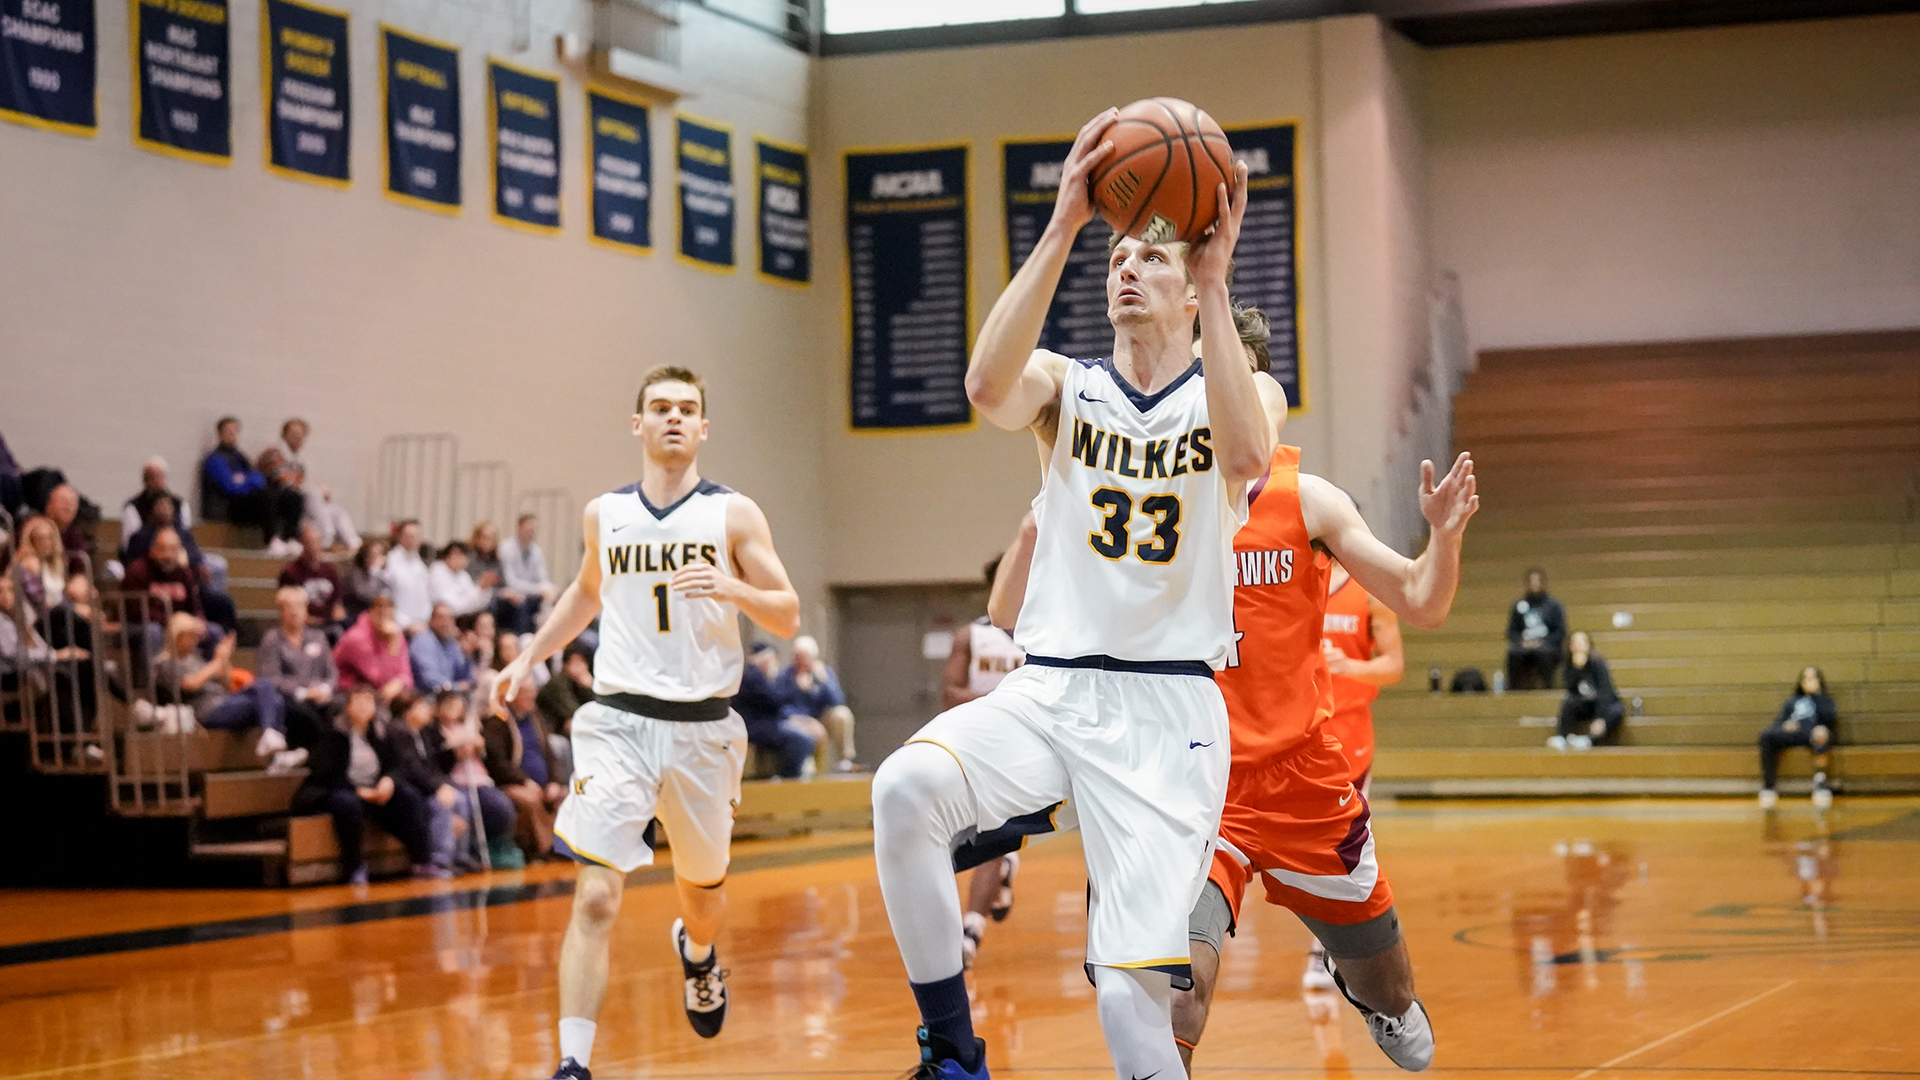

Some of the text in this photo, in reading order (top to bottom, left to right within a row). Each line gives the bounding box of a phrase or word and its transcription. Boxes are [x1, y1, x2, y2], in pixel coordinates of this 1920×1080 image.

[2, 14, 84, 53] CHAMPIONS
[148, 63, 223, 100] CHAMPIONS
[1071, 414, 1214, 480] WILKES
[1087, 485, 1183, 566] 33
[652, 582, 671, 634] 1
